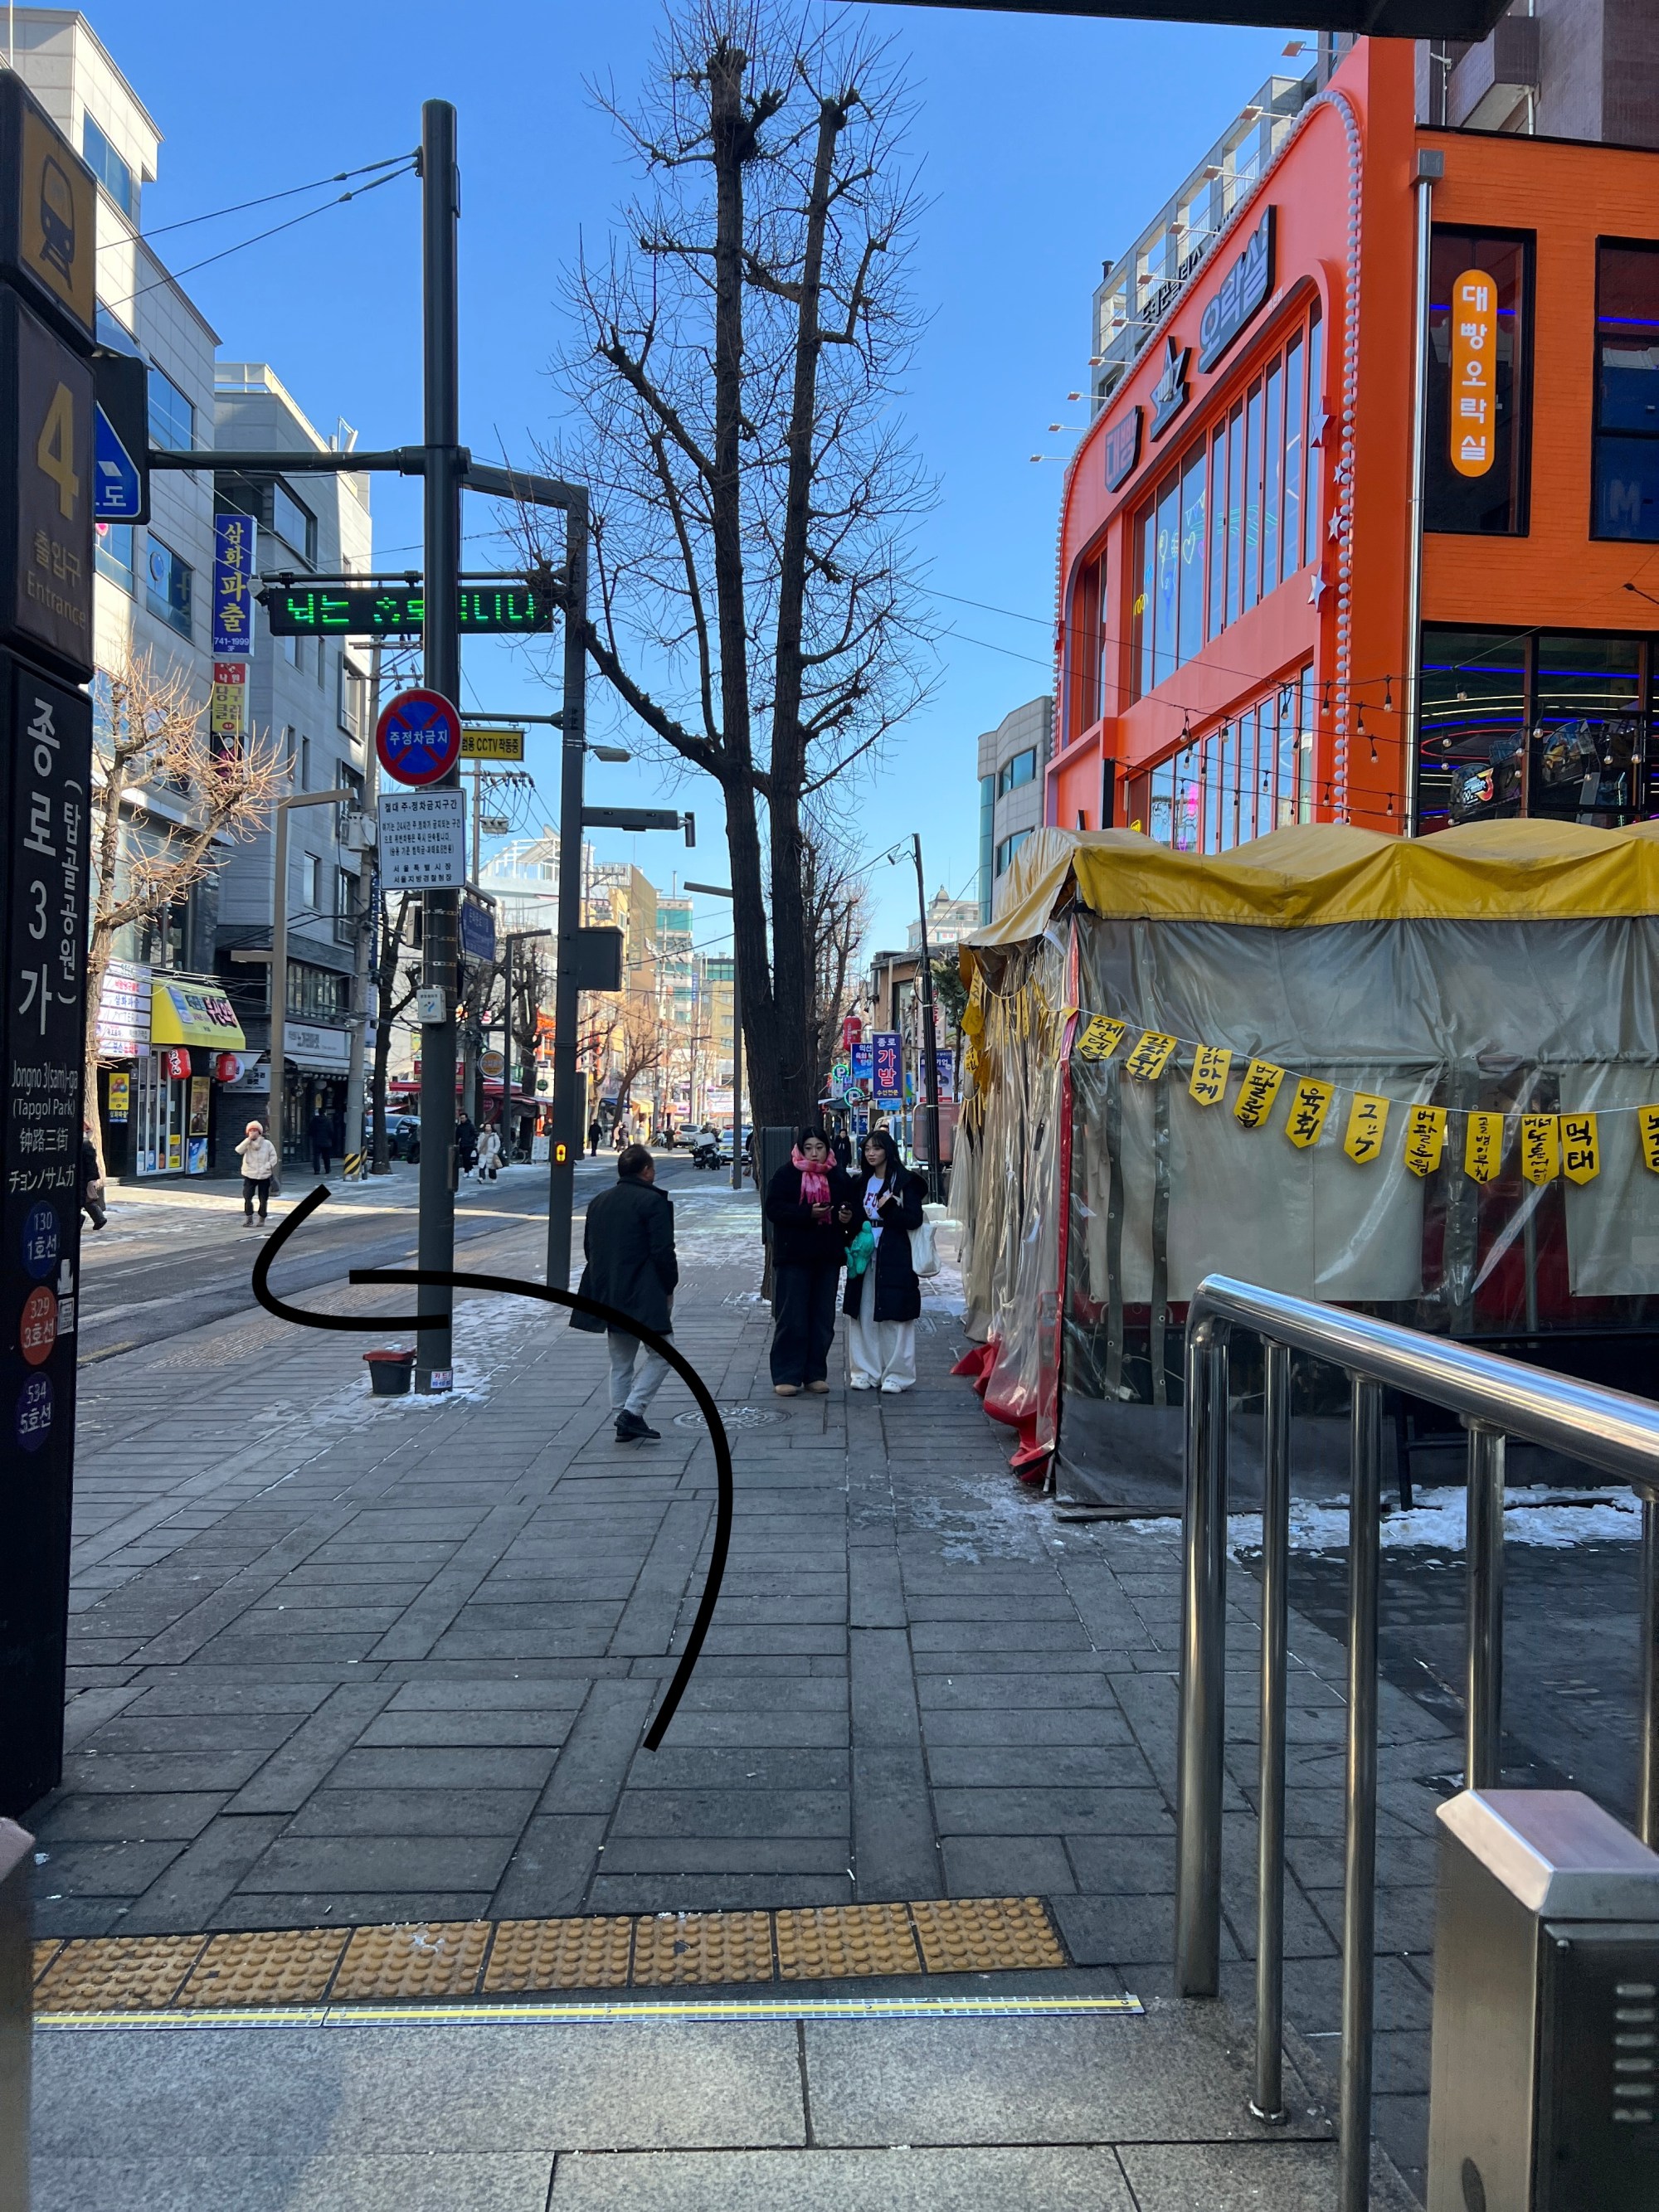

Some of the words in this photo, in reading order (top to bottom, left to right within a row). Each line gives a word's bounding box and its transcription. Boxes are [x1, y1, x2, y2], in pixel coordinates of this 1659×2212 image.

[1203, 217, 1269, 350] 오락실
[1461, 285, 1488, 460] 대빵오락실
[37, 381, 80, 521] 4
[34, 529, 80, 587] 출입구
[219, 522, 246, 633] 삼화파출
[27, 570, 86, 630] Entrance
[214, 637, 249, 645] 741-1999
[389, 729, 448, 746] 주정차금지
[477, 737, 498, 752] CCTV
[499, 738, 518, 753] 작동중
[385, 802, 398, 813] 절대
[877, 1038, 897, 1047] 종로
[12, 1060, 41, 1095] Jongno
[43, 1062, 78, 1096] 3(sam)-ga
[878, 1048, 898, 1087] 가발
[12, 1098, 51, 1120] (Tapgol
[53, 1099, 75, 1117] Park)
[1292, 1087, 1326, 1140] 육회
[20, 1127, 69, 1154] 钟路三街
[1566, 1120, 1594, 1171] 먹태
[9, 1163, 75, 1194] チョンノサムガ
[33, 1211, 53, 1231] 130
[27, 1233, 57, 1261] 1호선
[30, 1296, 50, 1319] 329
[23, 1317, 55, 1349] 3호선
[27, 1381, 46, 1405] 534
[20, 1402, 51, 1434] 5호선
